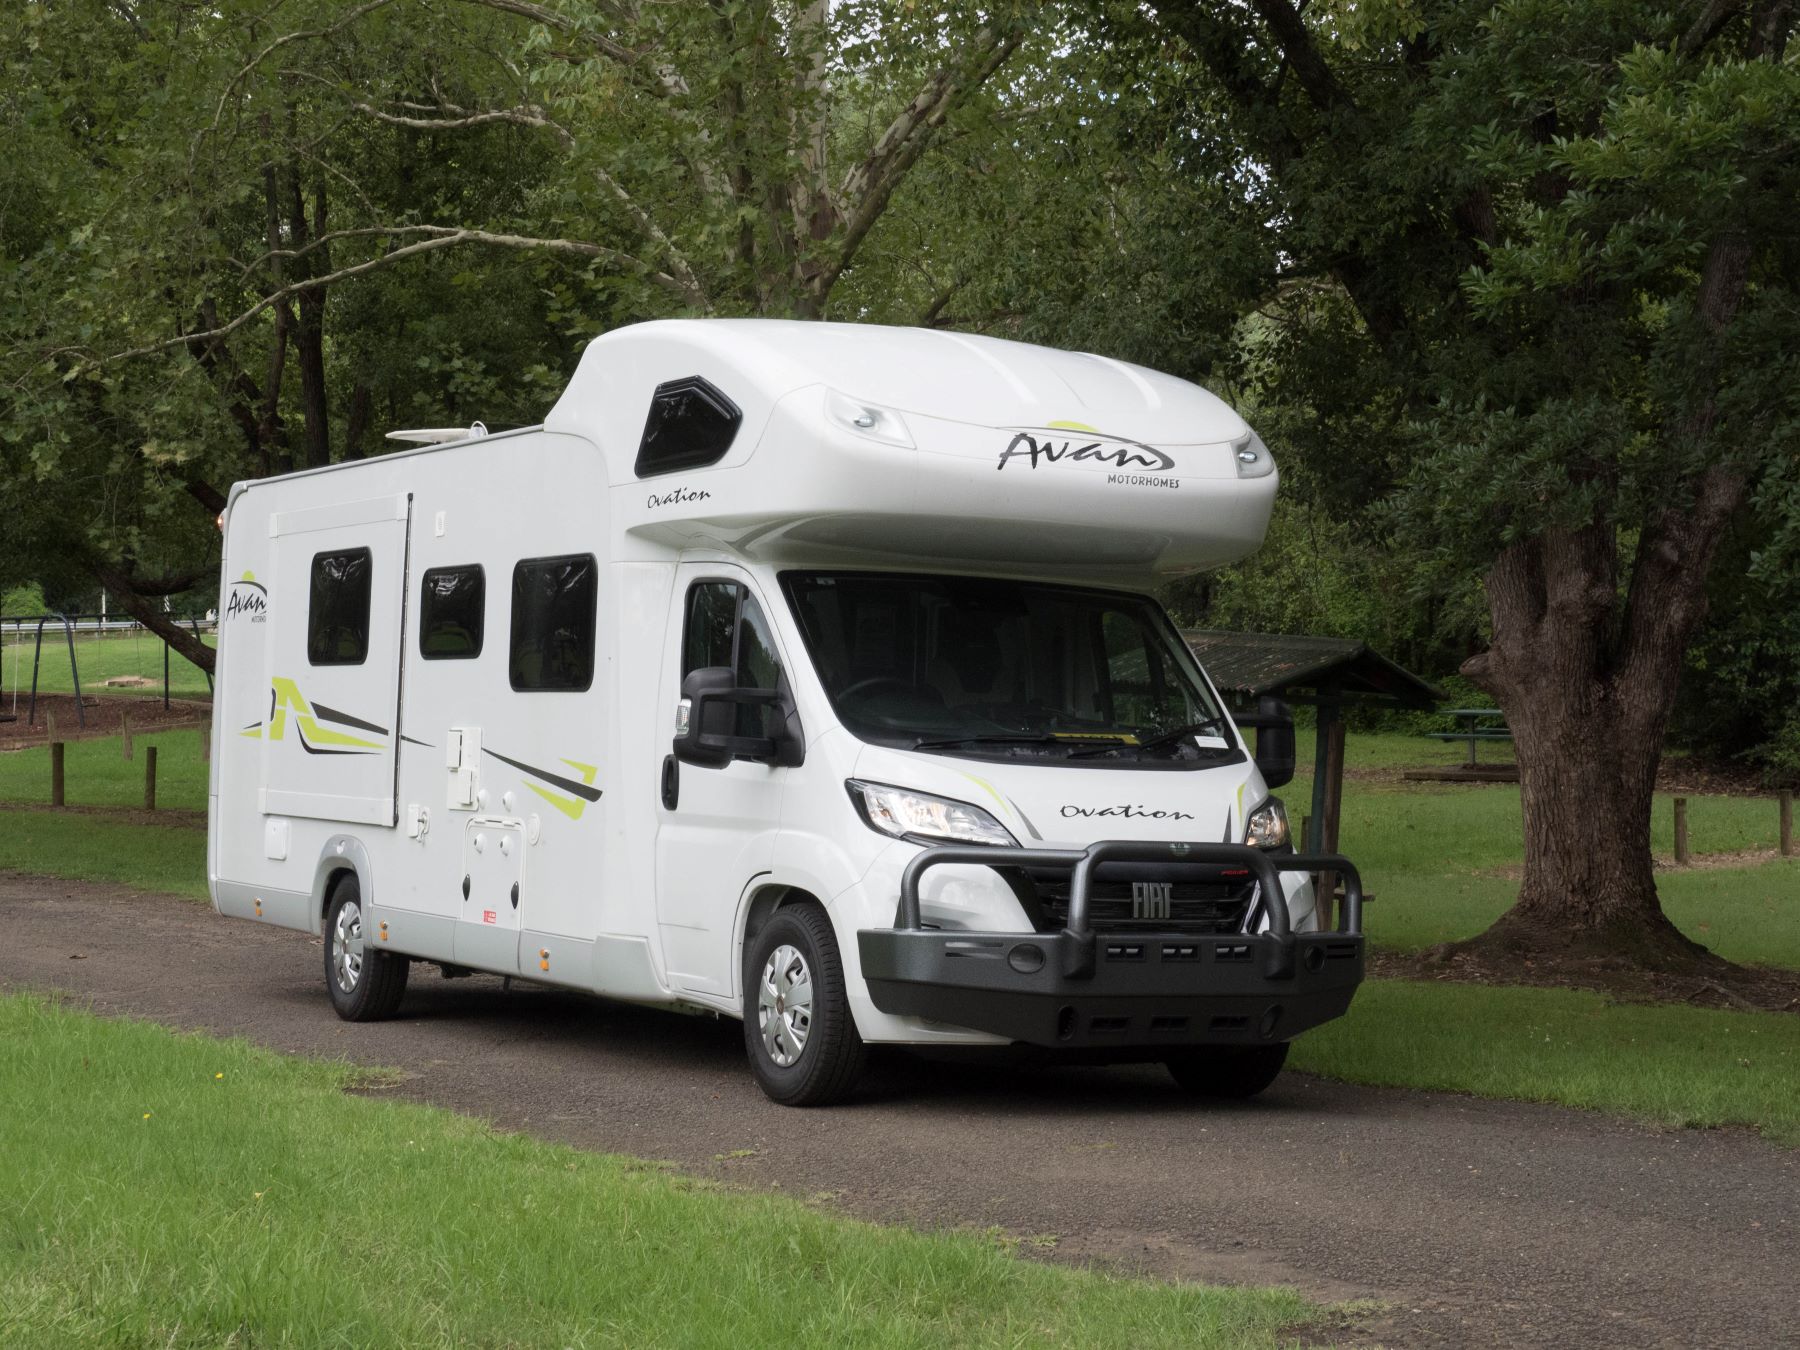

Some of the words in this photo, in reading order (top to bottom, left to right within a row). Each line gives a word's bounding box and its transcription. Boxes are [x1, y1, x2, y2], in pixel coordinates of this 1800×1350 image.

[997, 432, 1158, 470] Avan
[1107, 473, 1180, 489] MOTORHOMES
[647, 486, 712, 508] Ovation
[226, 588, 267, 621] Avan
[1059, 804, 1195, 820] Ovation
[1132, 882, 1173, 919] FIAT
